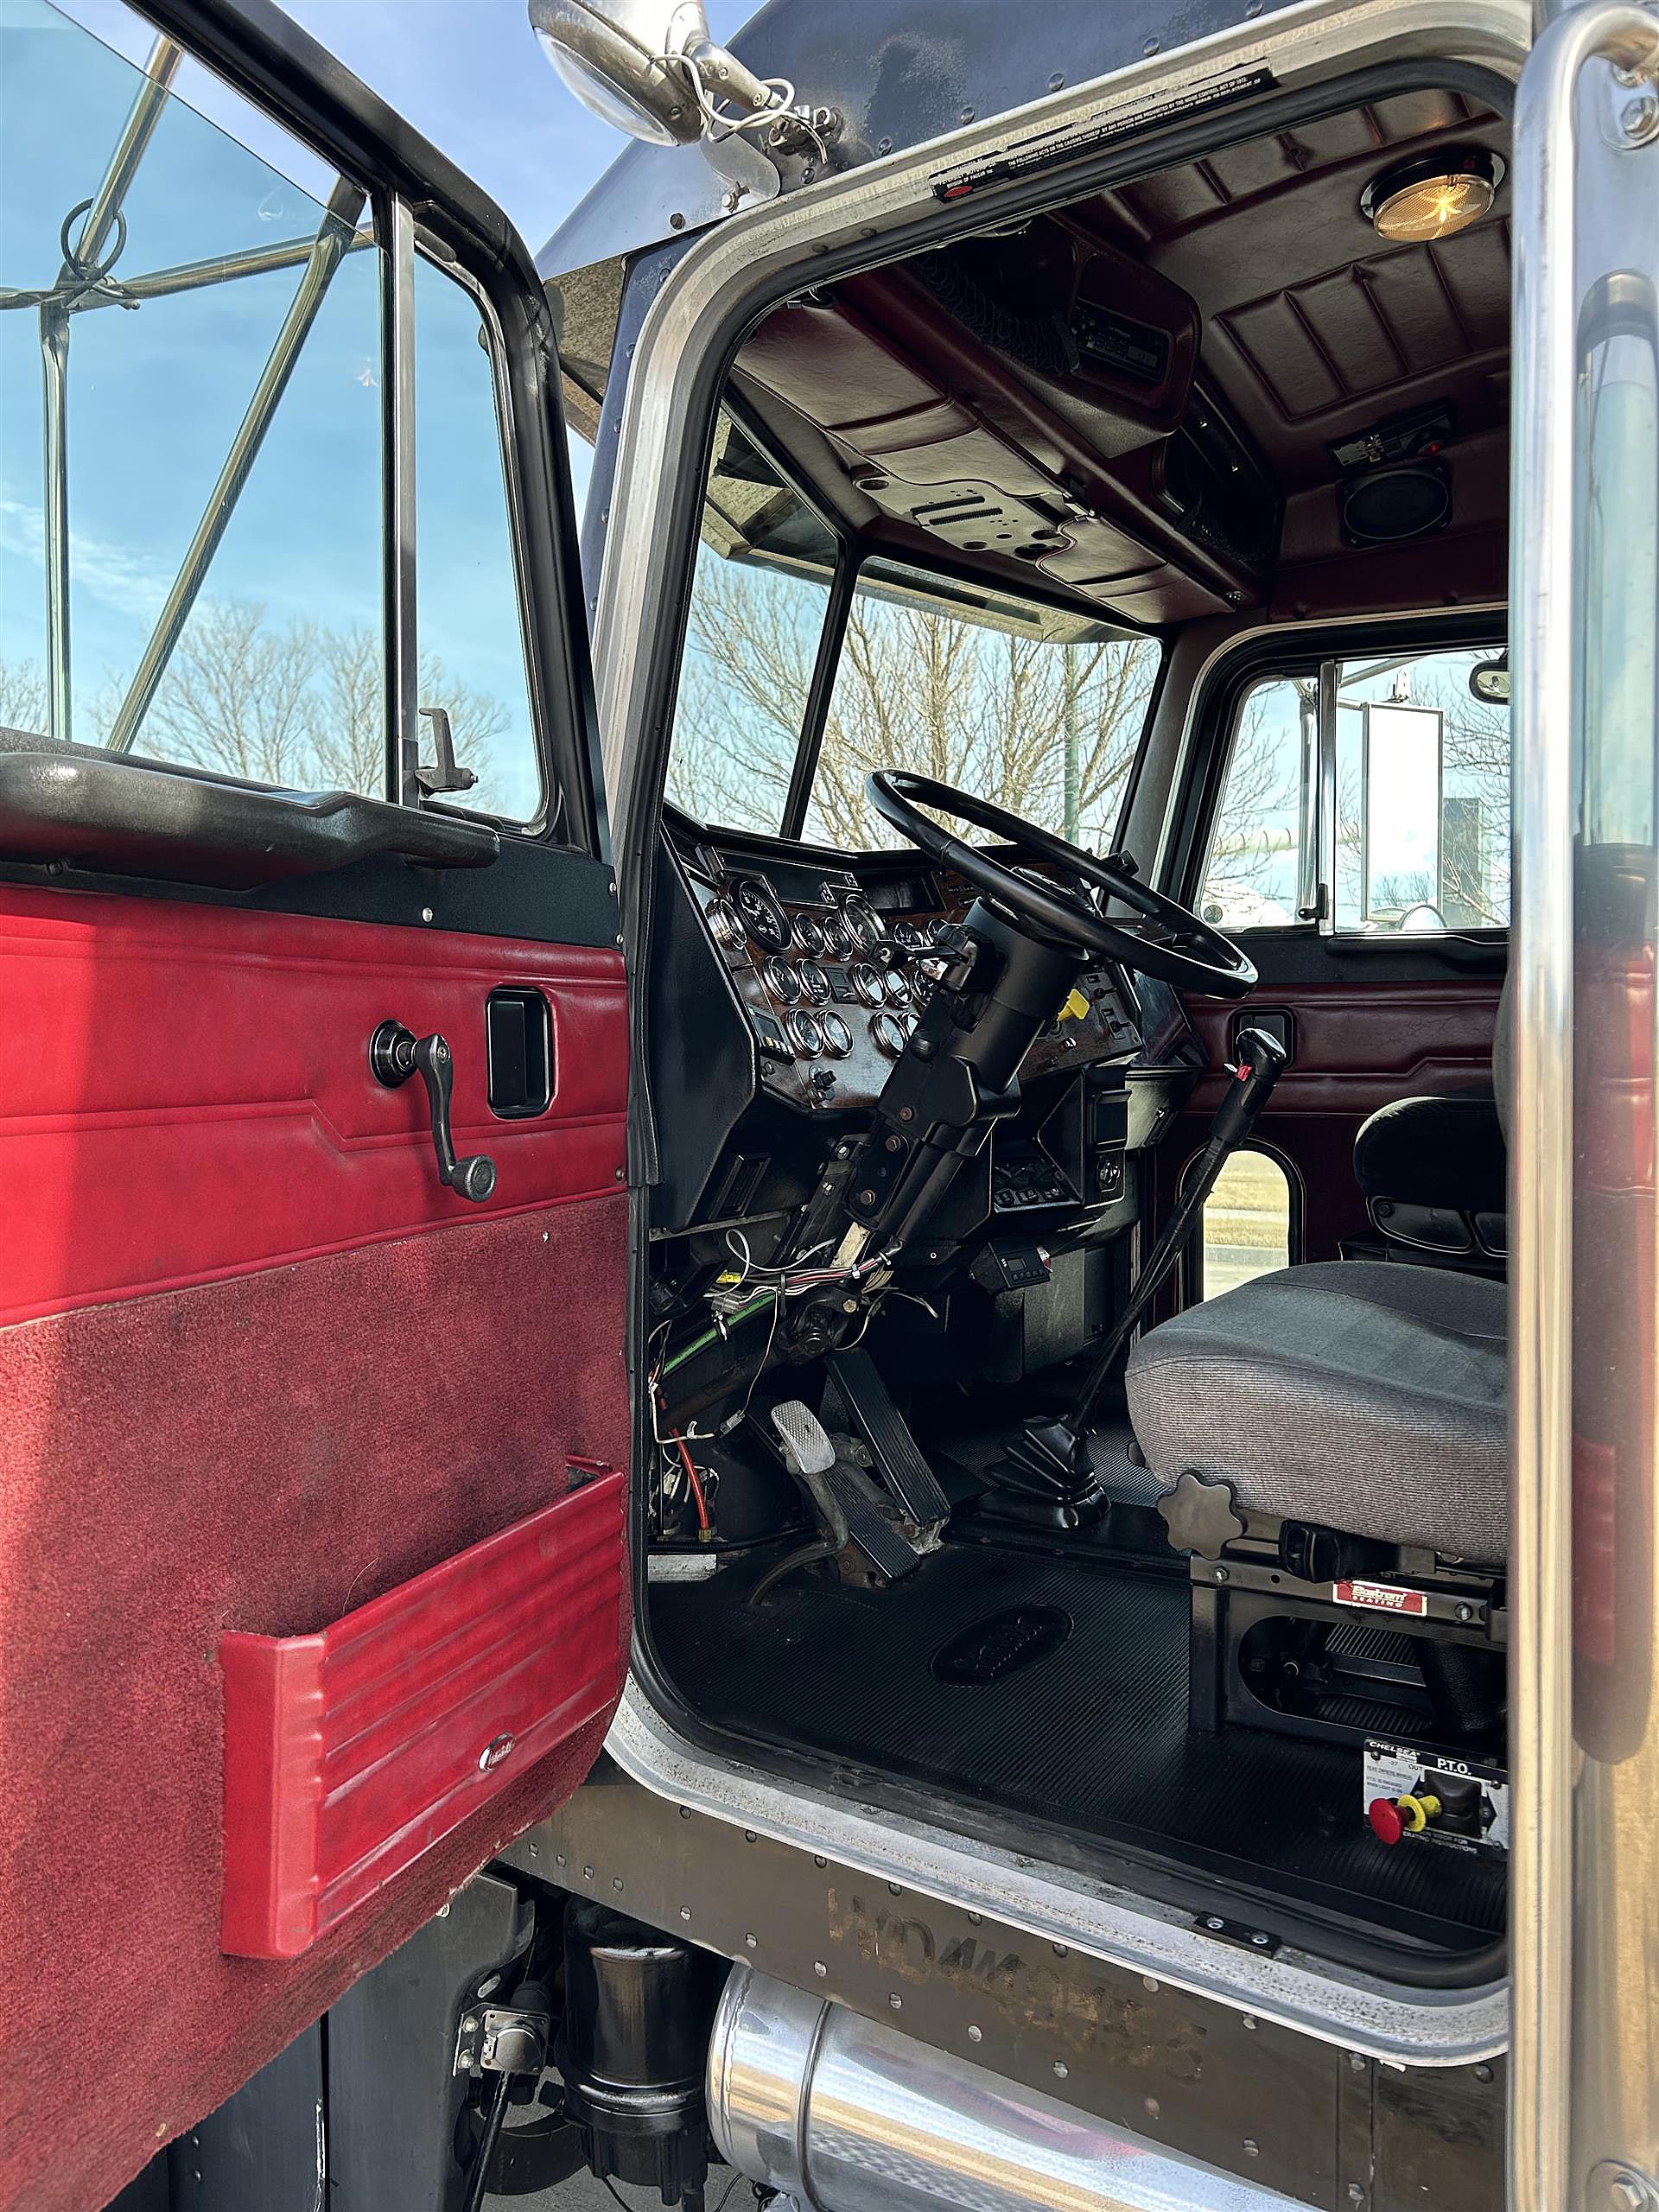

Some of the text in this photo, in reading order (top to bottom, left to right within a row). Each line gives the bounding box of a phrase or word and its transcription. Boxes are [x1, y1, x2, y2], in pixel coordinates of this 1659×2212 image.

[1352, 1595, 1403, 1608] SEATING
[1369, 1741, 1417, 1757] CHELSEA
[1408, 1764, 1423, 1772] OUT
[1437, 1758, 1471, 1776] P.T.O.
